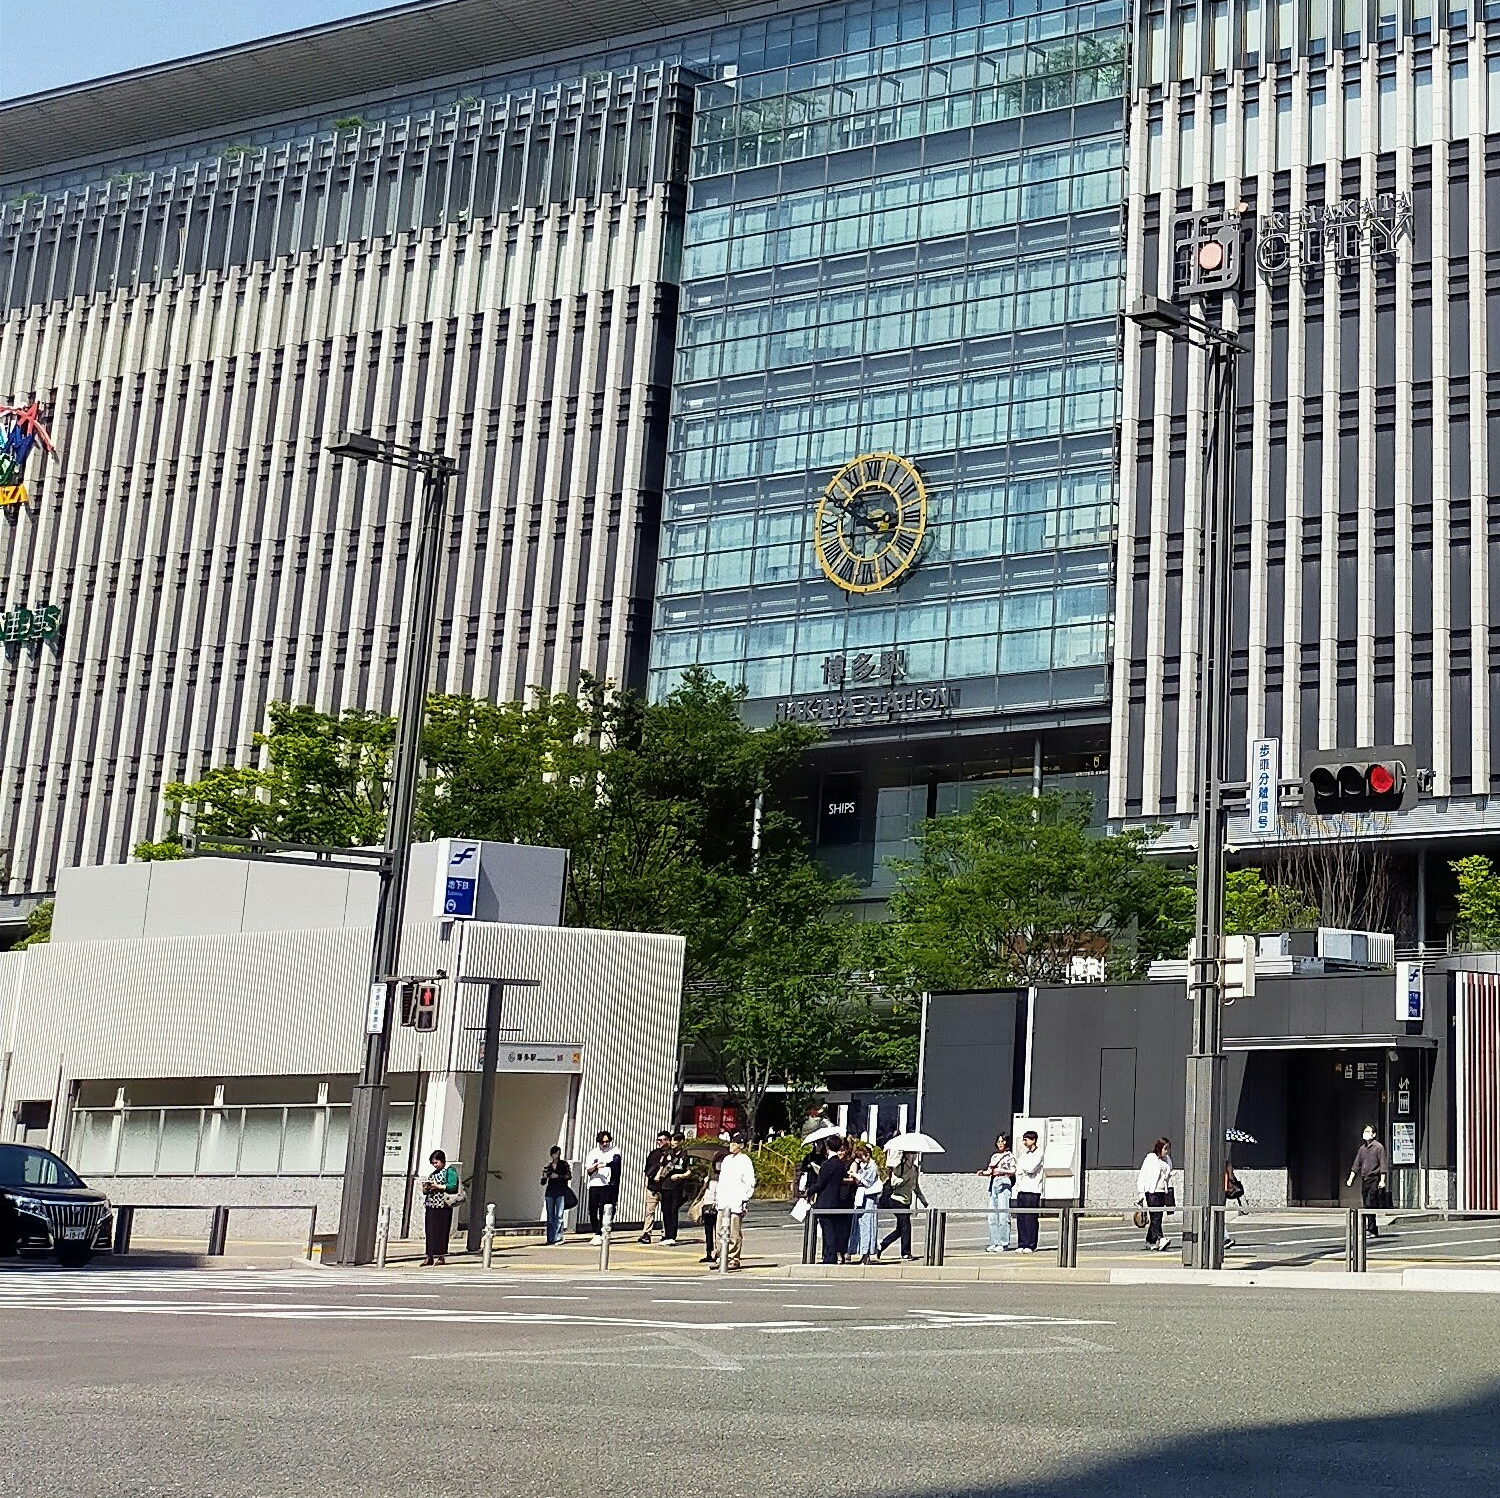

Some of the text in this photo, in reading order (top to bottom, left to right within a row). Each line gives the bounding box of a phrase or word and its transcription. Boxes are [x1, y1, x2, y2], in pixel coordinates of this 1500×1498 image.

[1300, 191, 1412, 223] HAKATA
[1255, 212, 1413, 272] CITY
[820, 650, 907, 685] 博多駅
[775, 686, 950, 722] HAKATA STATION
[828, 801, 856, 815] SHIPS
